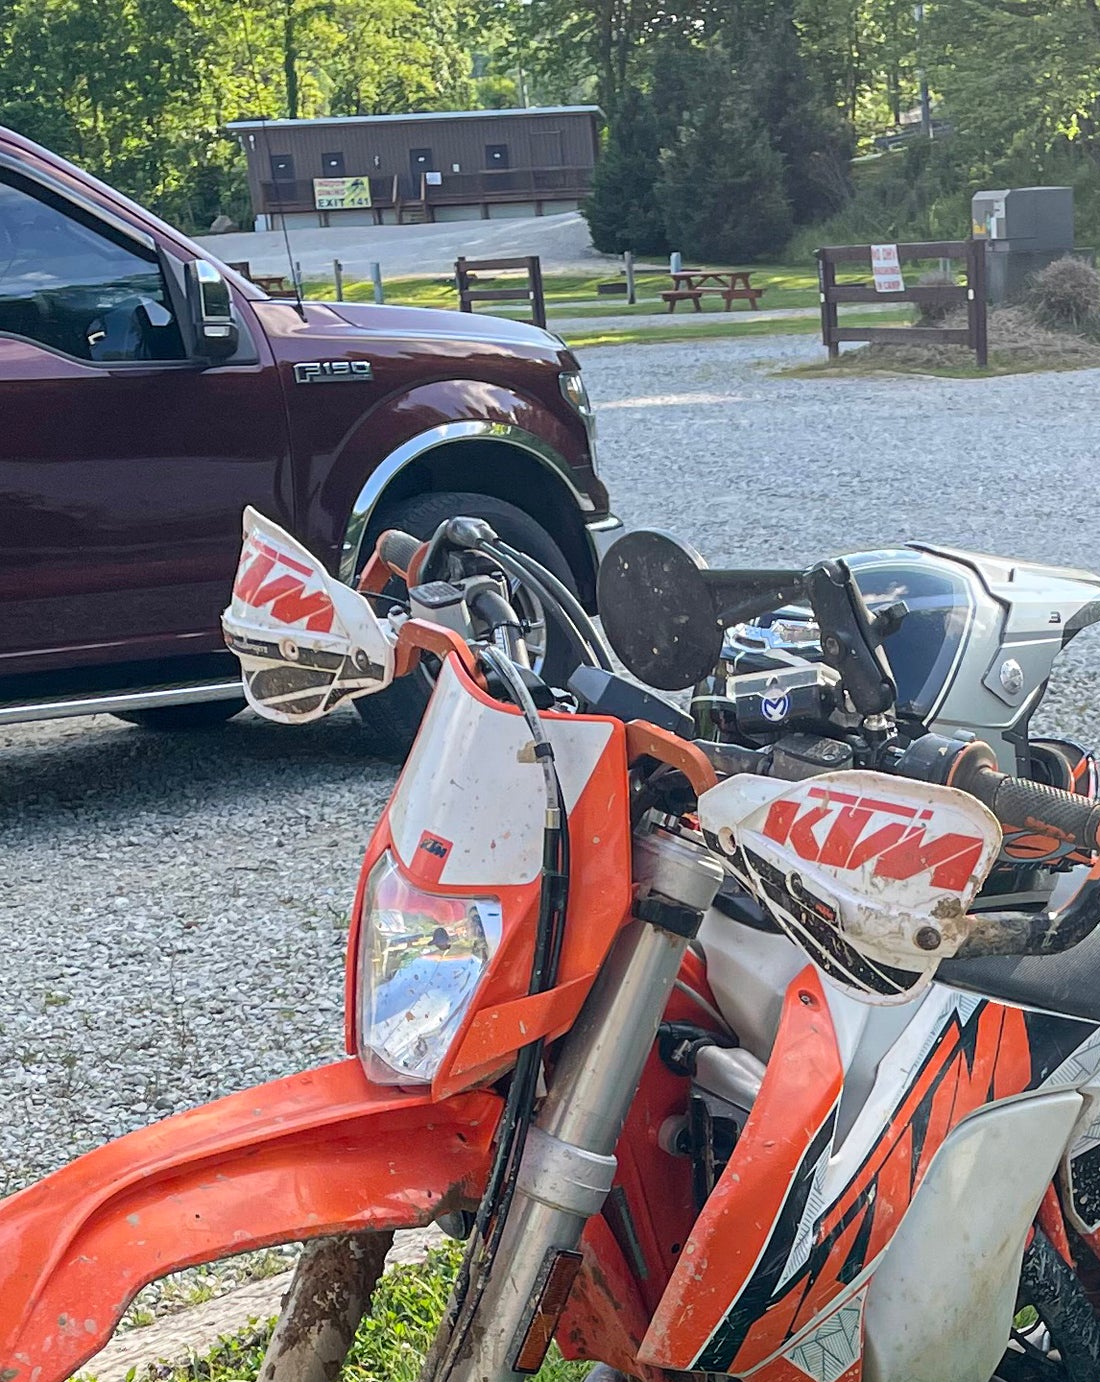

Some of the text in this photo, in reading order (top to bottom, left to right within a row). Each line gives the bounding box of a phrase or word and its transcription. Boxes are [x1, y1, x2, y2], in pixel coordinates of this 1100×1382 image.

[318, 197, 369, 207] EXIT 141
[293, 361, 371, 384] F150
[233, 536, 335, 634] TM
[420, 838, 448, 859] KTM
[763, 787, 983, 892] KTM
